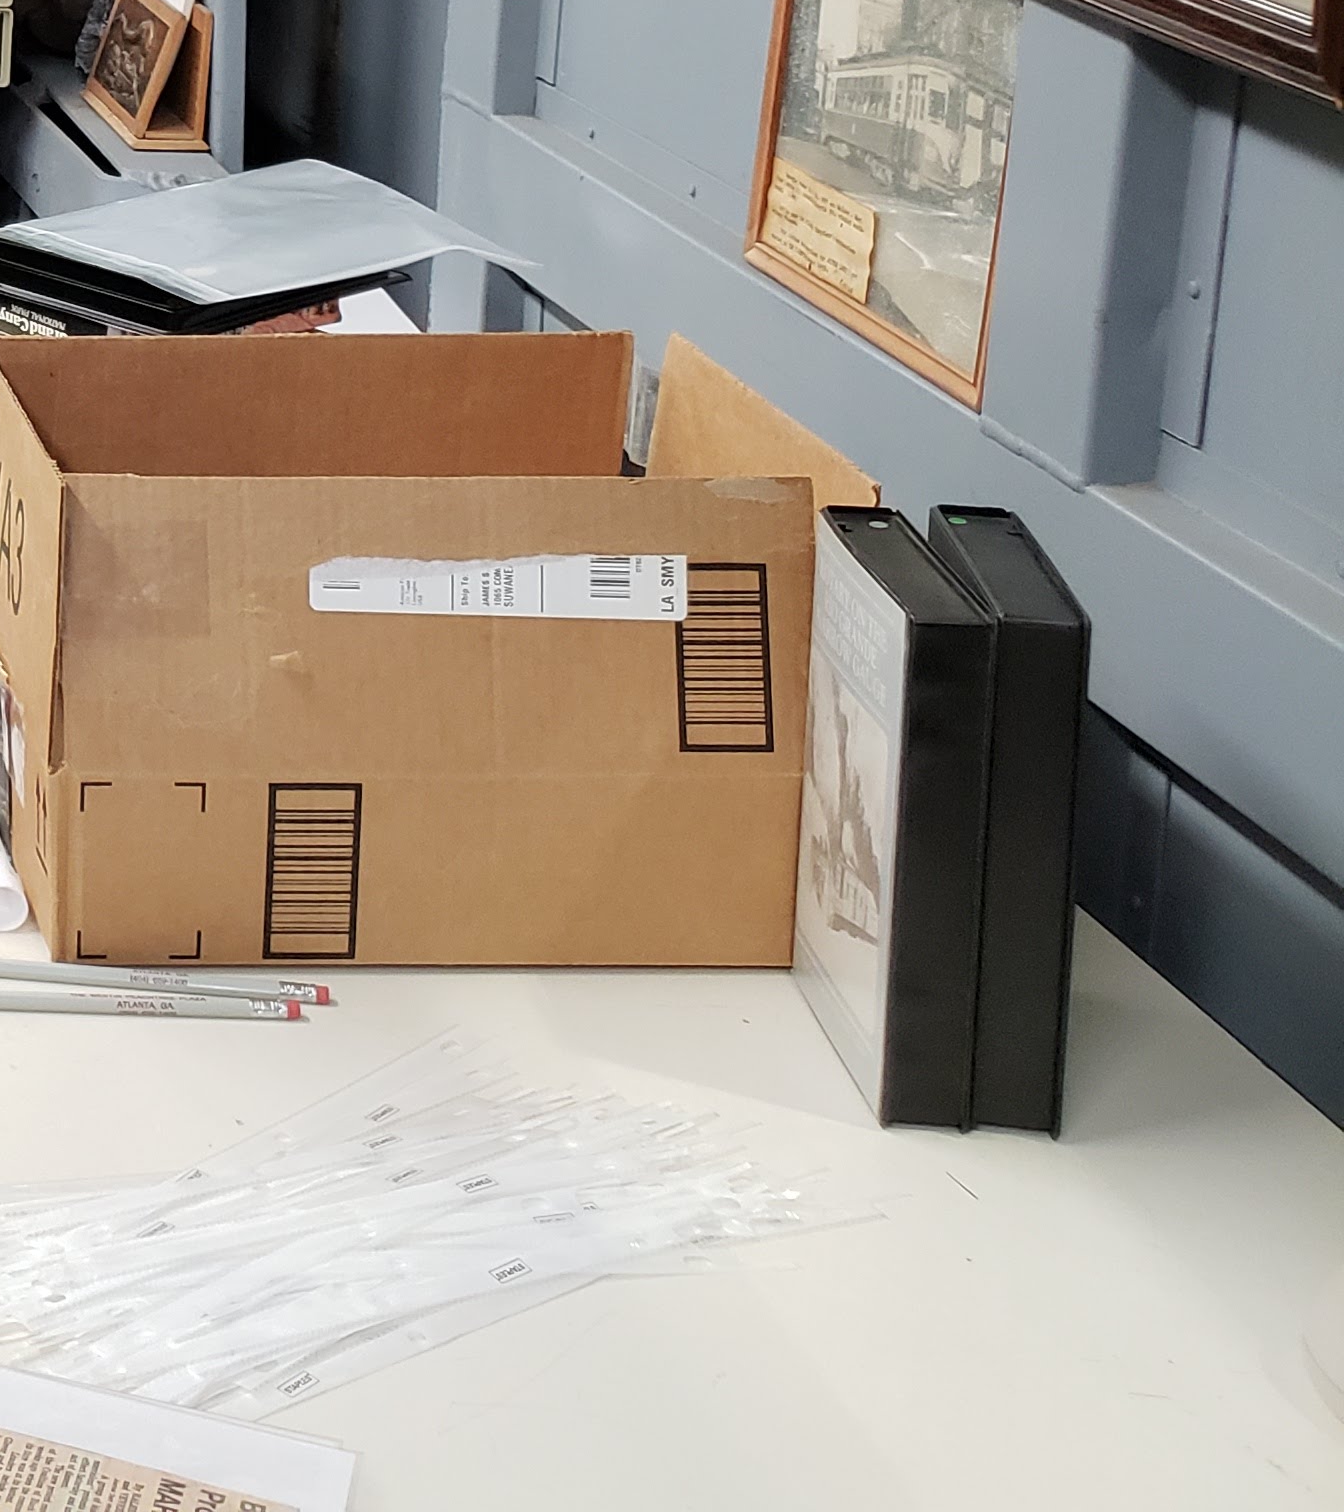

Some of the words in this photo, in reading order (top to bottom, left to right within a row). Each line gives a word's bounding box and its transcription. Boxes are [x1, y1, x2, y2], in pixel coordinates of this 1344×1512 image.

[460, 586, 470, 607] Ship
[481, 581, 491, 608] JAMES
[660, 594, 675, 614] LA
[494, 1262, 527, 1282] STAPLES
[283, 1372, 313, 1395] STAPLES
